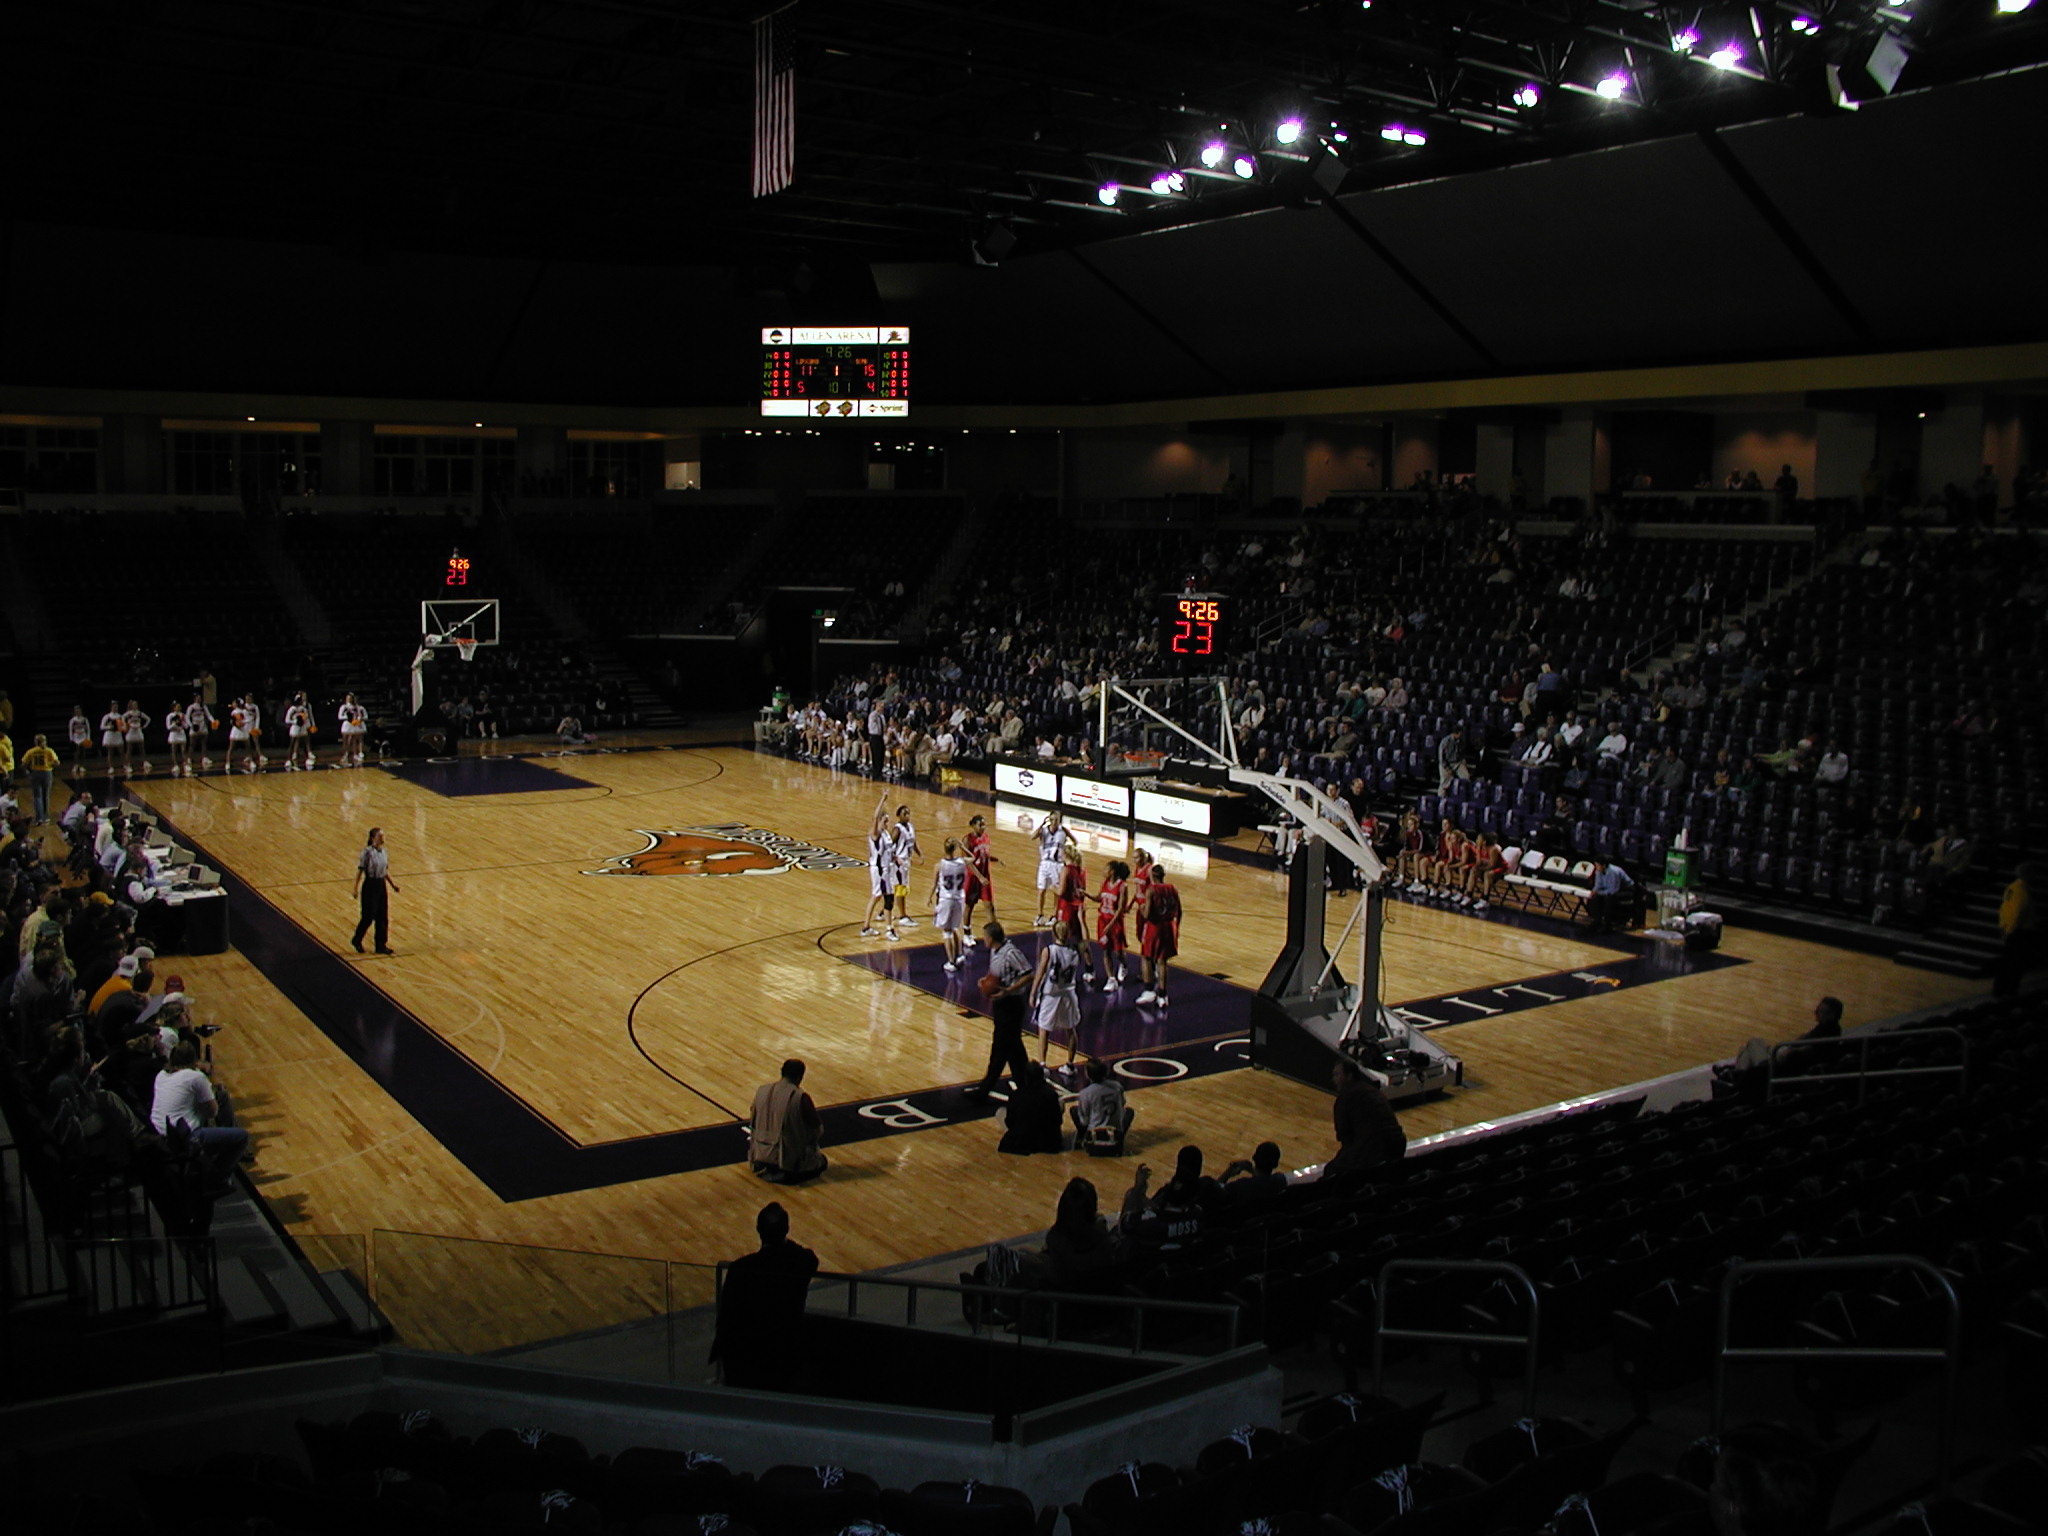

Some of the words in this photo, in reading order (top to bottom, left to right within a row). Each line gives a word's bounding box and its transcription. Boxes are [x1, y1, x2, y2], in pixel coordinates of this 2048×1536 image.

[798, 331, 833, 341] ALLEN
[836, 331, 872, 341] ARENA
[446, 569, 467, 586] 23
[1179, 600, 1219, 621] 9:26
[1172, 620, 1213, 655] 23
[1167, 1218, 1199, 1238] MOSS
